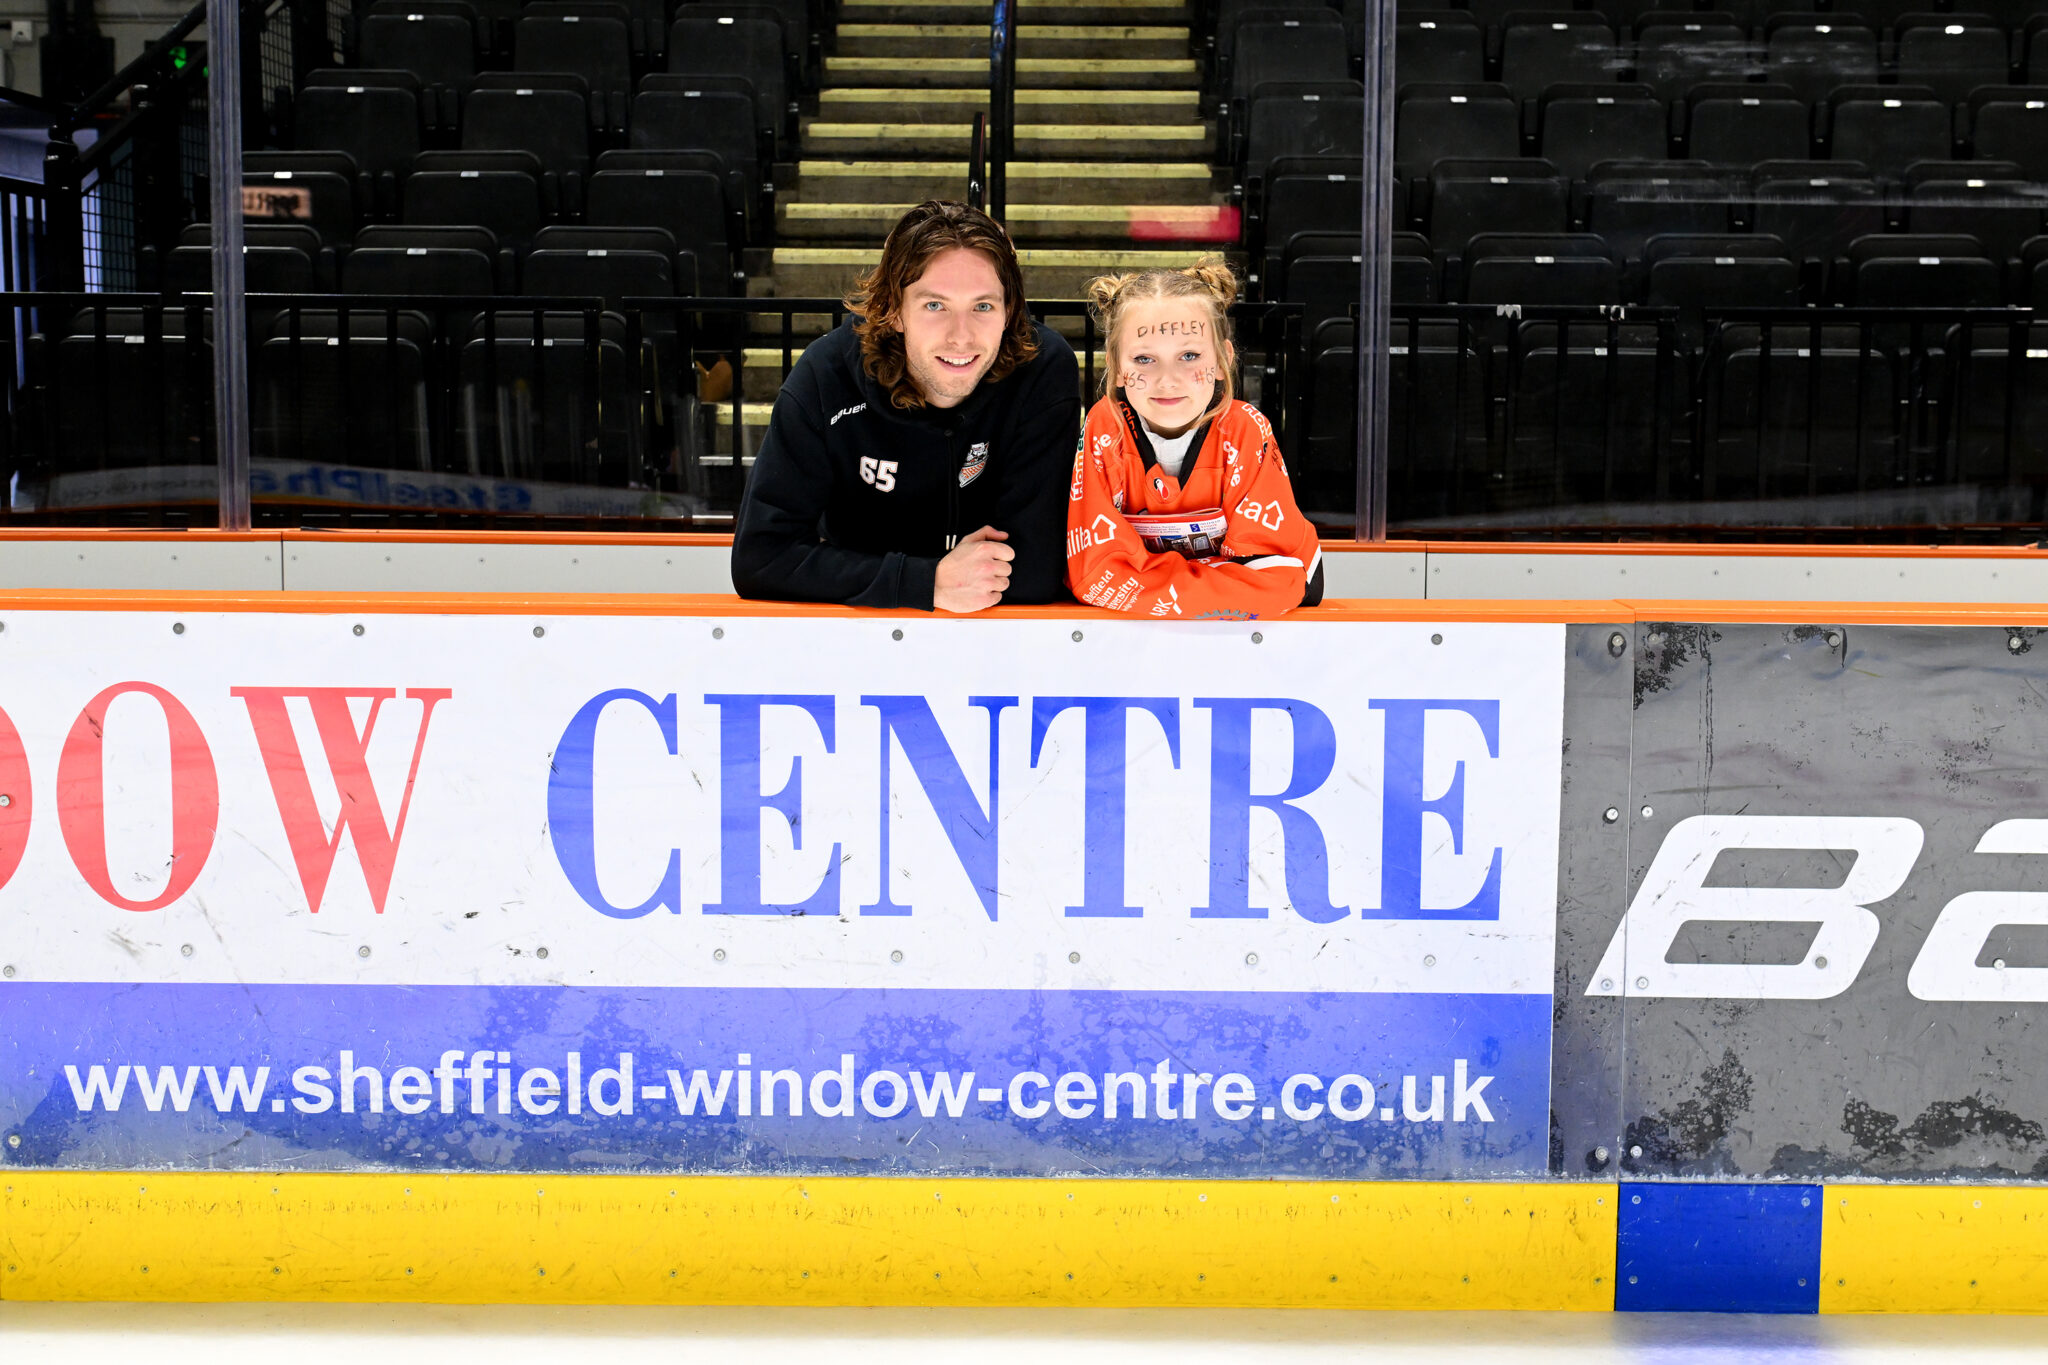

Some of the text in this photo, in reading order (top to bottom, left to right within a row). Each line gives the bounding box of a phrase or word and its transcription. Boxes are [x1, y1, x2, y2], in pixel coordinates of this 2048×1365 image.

[1137, 320, 1206, 338] DIFFLEY
[859, 455, 899, 493] 65
[1066, 526, 1092, 559] ilita
[0, 681, 1503, 924] OW CENTRE
[64, 1049, 1494, 1126] www.sheffield-window-centre.co.uk
